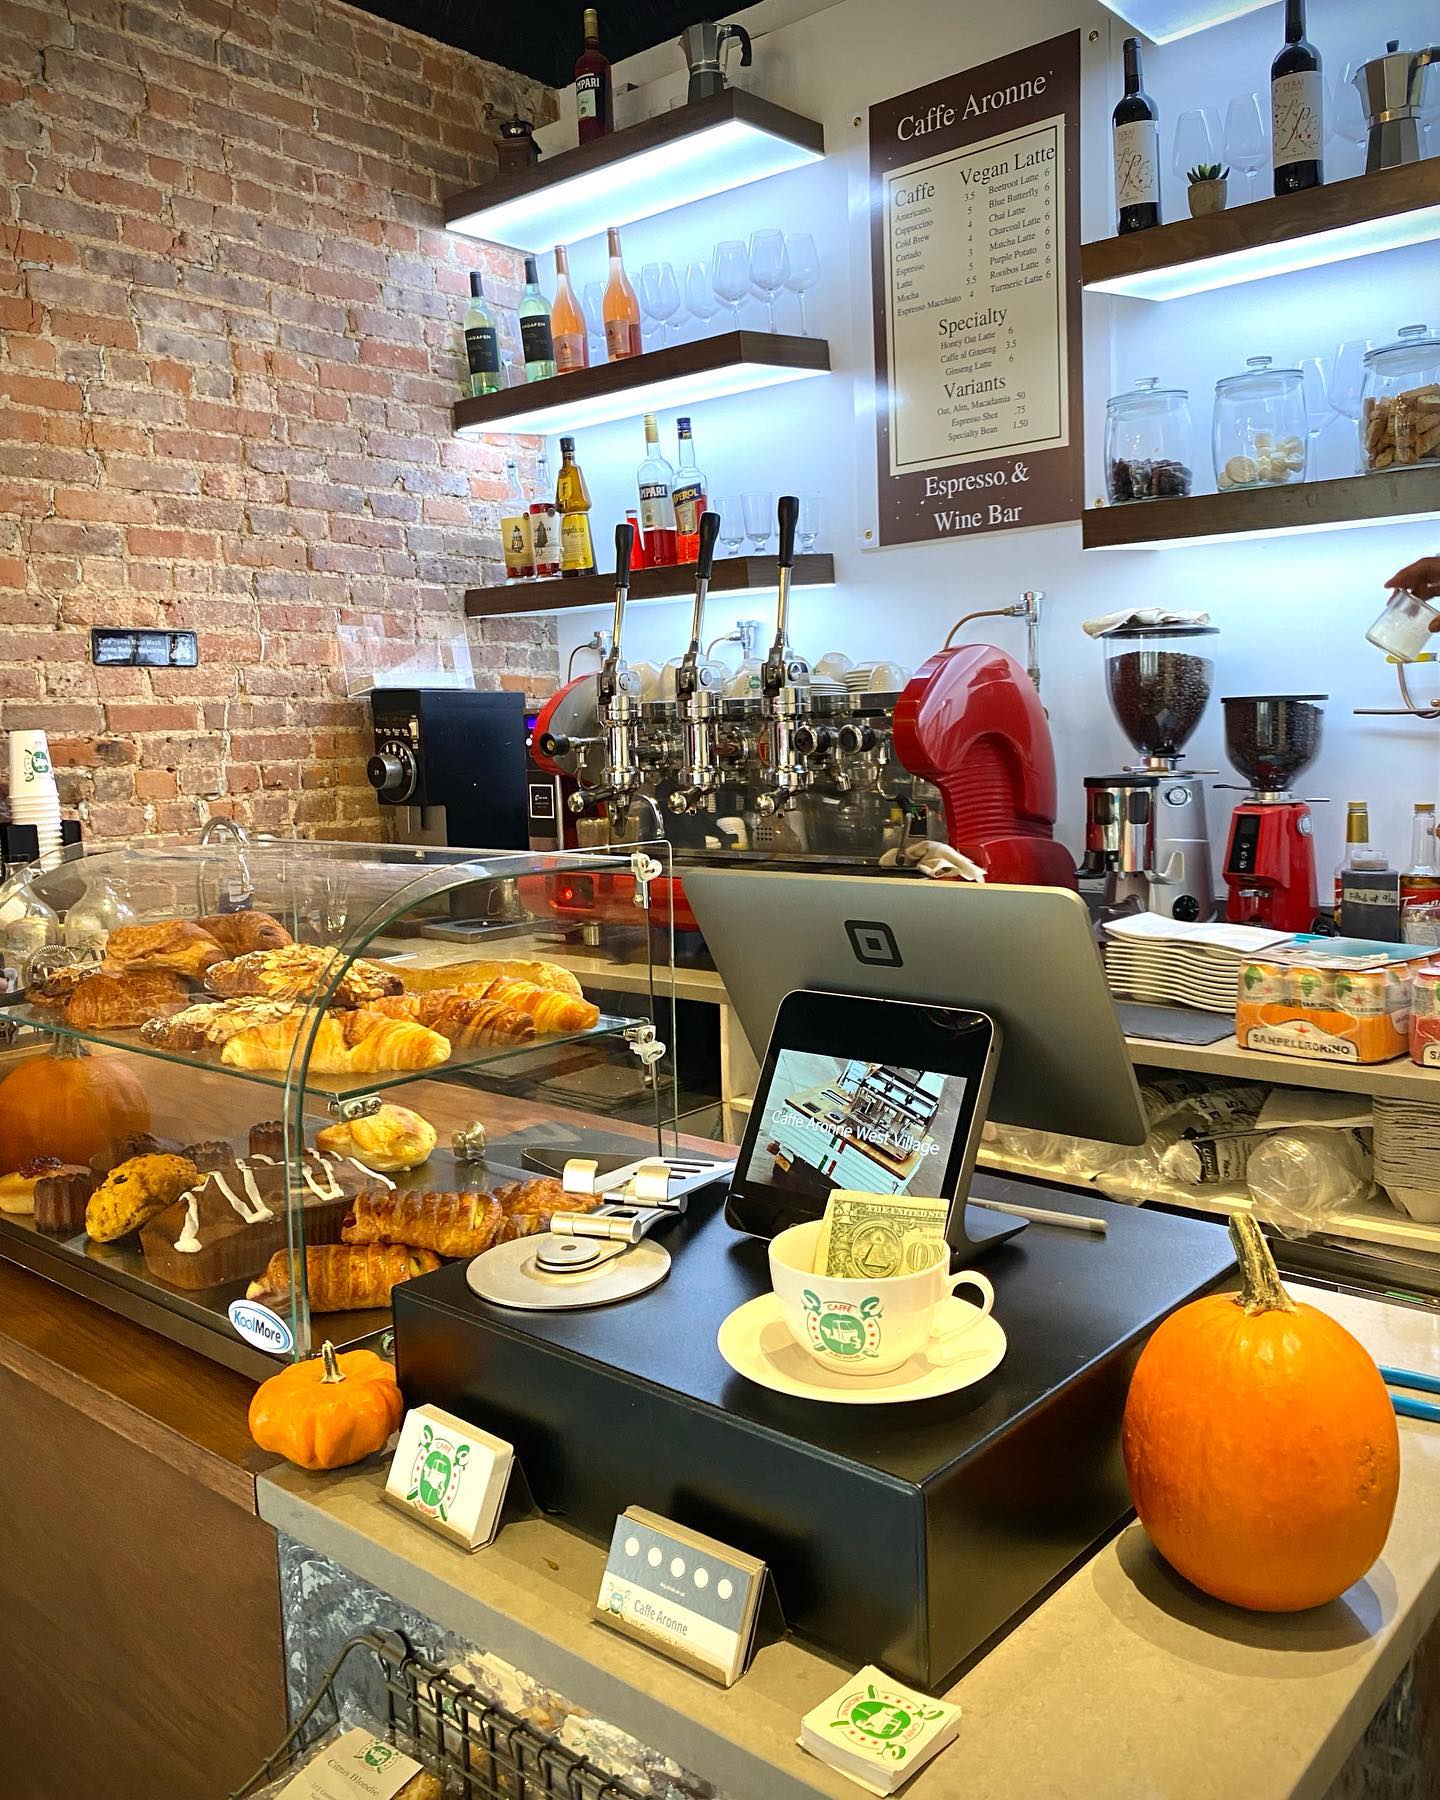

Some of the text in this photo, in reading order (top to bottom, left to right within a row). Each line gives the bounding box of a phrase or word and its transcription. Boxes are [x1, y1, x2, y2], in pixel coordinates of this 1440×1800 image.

[576, 77, 600, 91] MPARI
[897, 75, 1047, 141] Caffe Aronne
[960, 147, 1056, 186] Vegan Latte
[989, 168, 1050, 194] Beetroot Latte 6
[895, 182, 936, 207] Caffe
[989, 182, 1050, 208] Blue Butterfly 6
[895, 206, 972, 236] Cappuccino 5
[989, 196, 1050, 222] Chai Latte 6
[989, 211, 1050, 237] Charcoal Latte 6
[895, 238, 912, 249] Cold
[990, 225, 1050, 250] Matcha Latte 6
[895, 249, 922, 263] Cortado
[990, 240, 1051, 265] Purple Potato 6
[1020, 261, 1039, 272] Latte
[1045, 255, 1051, 264] 6
[896, 263, 925, 277] Espresso
[1024, 275, 1043, 285] Latte
[1045, 270, 1051, 279] 6
[896, 280, 913, 290] Latte
[897, 292, 920, 303] Mocha
[897, 304, 926, 317] Espresso
[927, 295, 962, 310] Macchiato
[938, 307, 1008, 339] Specialty
[941, 340, 963, 350] Honey
[978, 332, 996, 342] Latte
[1008, 326, 1013, 334] 6
[940, 353, 959, 363] Caffe
[1009, 354, 1014, 362] 6
[944, 375, 1006, 400] Variants
[951, 415, 981, 427] Espresso
[948, 429, 980, 442] Specialty
[980, 426, 998, 435] Bean
[640, 486, 667, 499] MPARI
[924, 461, 1030, 499] Espresso &
[933, 504, 1023, 532] Wine Bar
[771, 1109, 940, 1157] Caffe Aronne West Village
[866, 1204, 889, 1214] THE
[890, 1206, 927, 1218] UNITED
[927, 1210, 948, 1220] STA
[234, 1310, 281, 1344] KoolMore
[634, 1599, 688, 1636] Caffe Aronne
[327, 1759, 350, 1777] Citrus
[349, 1773, 380, 1797] Blondie
